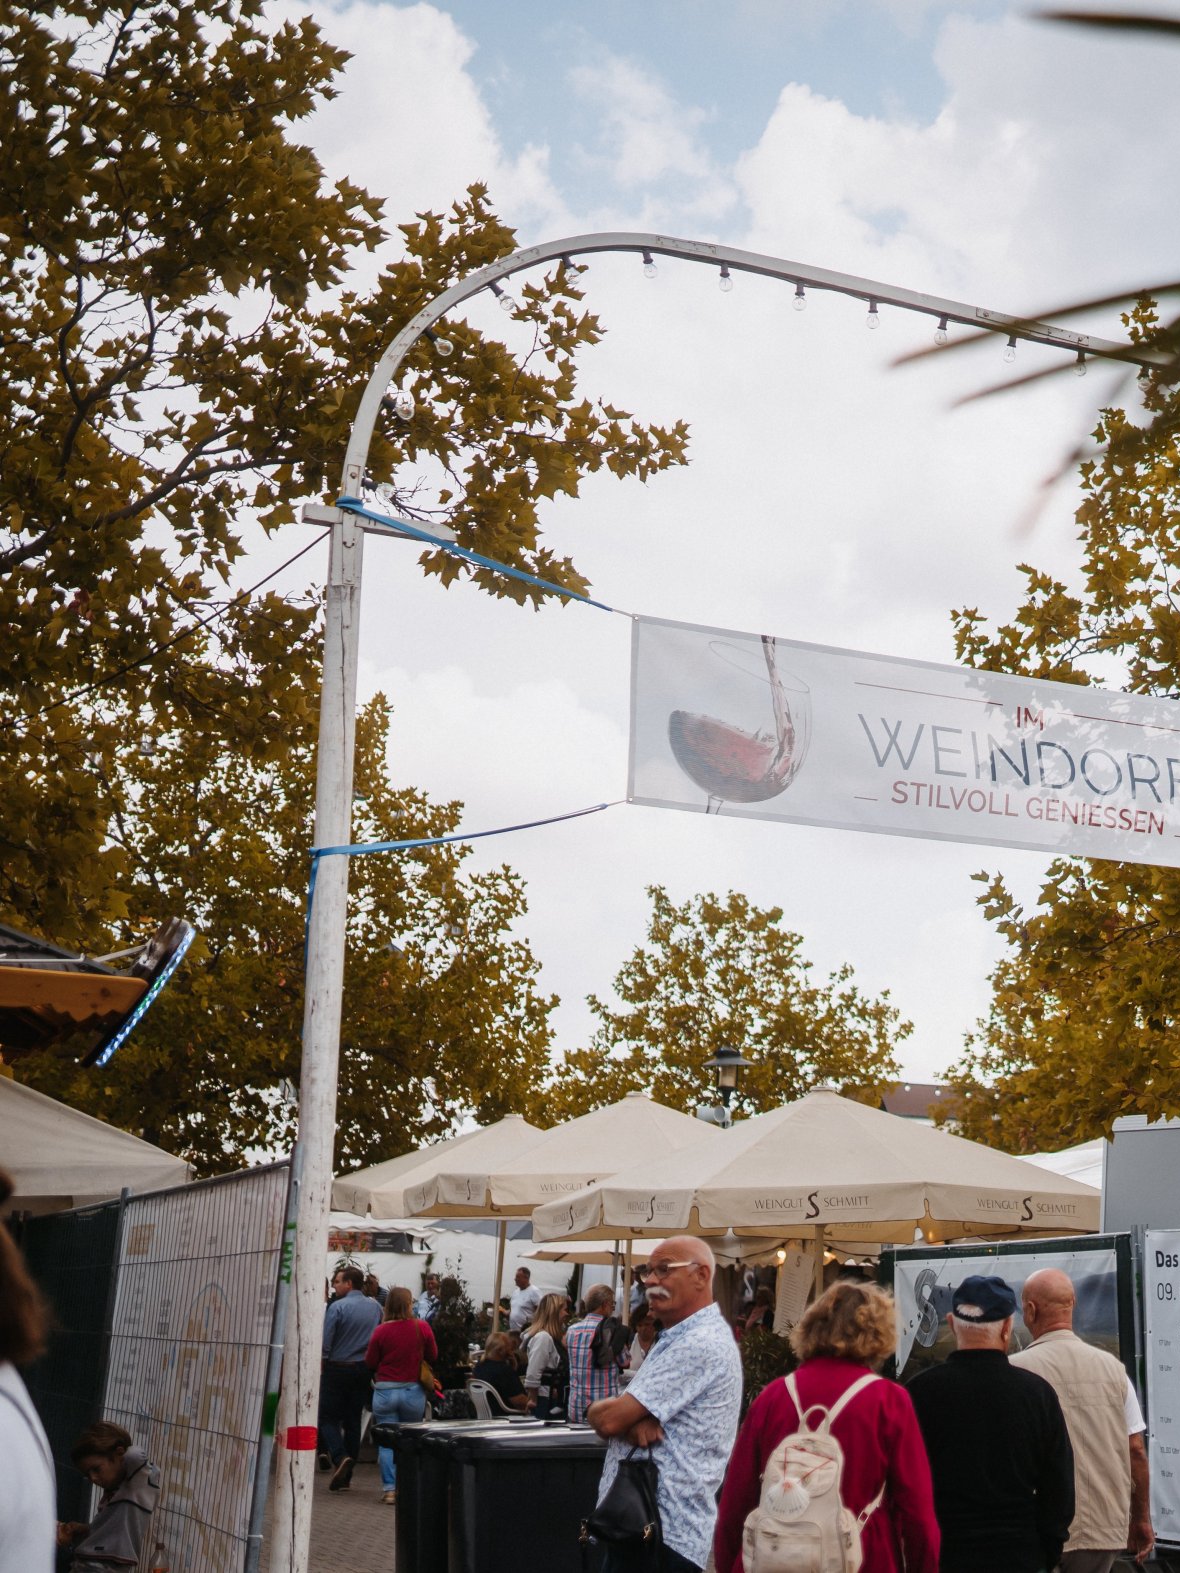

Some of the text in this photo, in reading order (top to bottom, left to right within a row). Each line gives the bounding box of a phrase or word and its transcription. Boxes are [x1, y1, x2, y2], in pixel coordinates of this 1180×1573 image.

[1016, 706, 1045, 731] IM
[891, 780, 1165, 836] STILVOLL GENIESSEN
[754, 1198, 803, 1209] WEINGUT
[823, 1195, 869, 1208] SCHMITT
[977, 1197, 1020, 1211] WEINGUT
[1036, 1203, 1077, 1214] SCHMITT
[1156, 1250, 1179, 1268] Das
[1156, 1283, 1177, 1301] 09.
